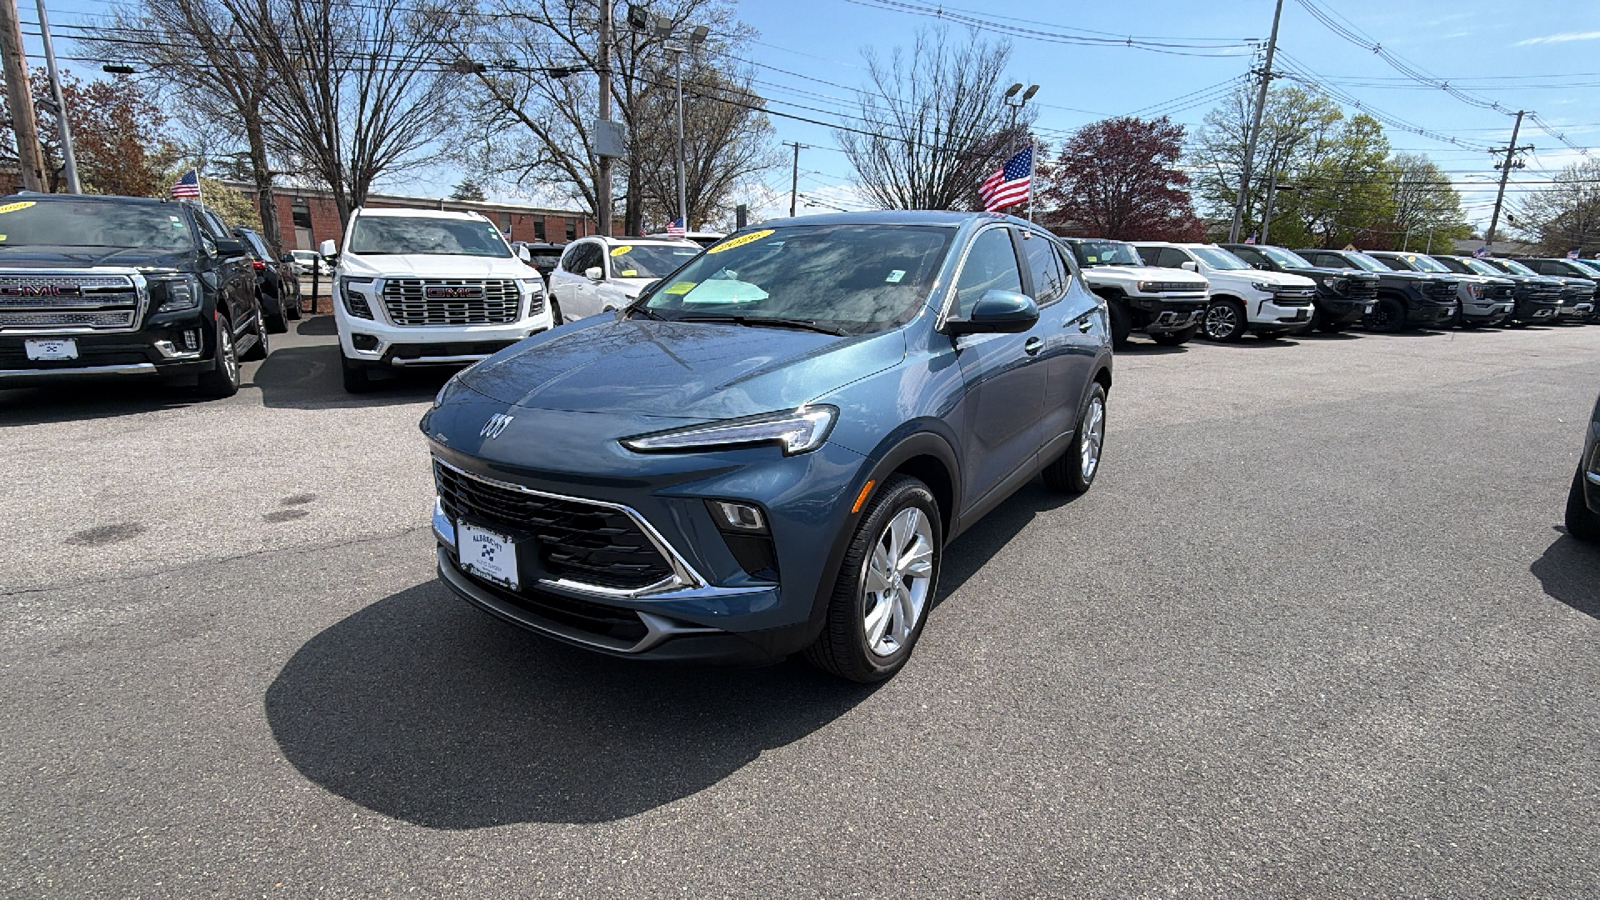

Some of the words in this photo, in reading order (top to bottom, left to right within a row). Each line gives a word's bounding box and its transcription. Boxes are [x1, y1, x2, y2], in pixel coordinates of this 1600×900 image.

[0, 284, 80, 296] GMC
[428, 287, 482, 298] GMC
[472, 535, 502, 552] ALBRECHT
